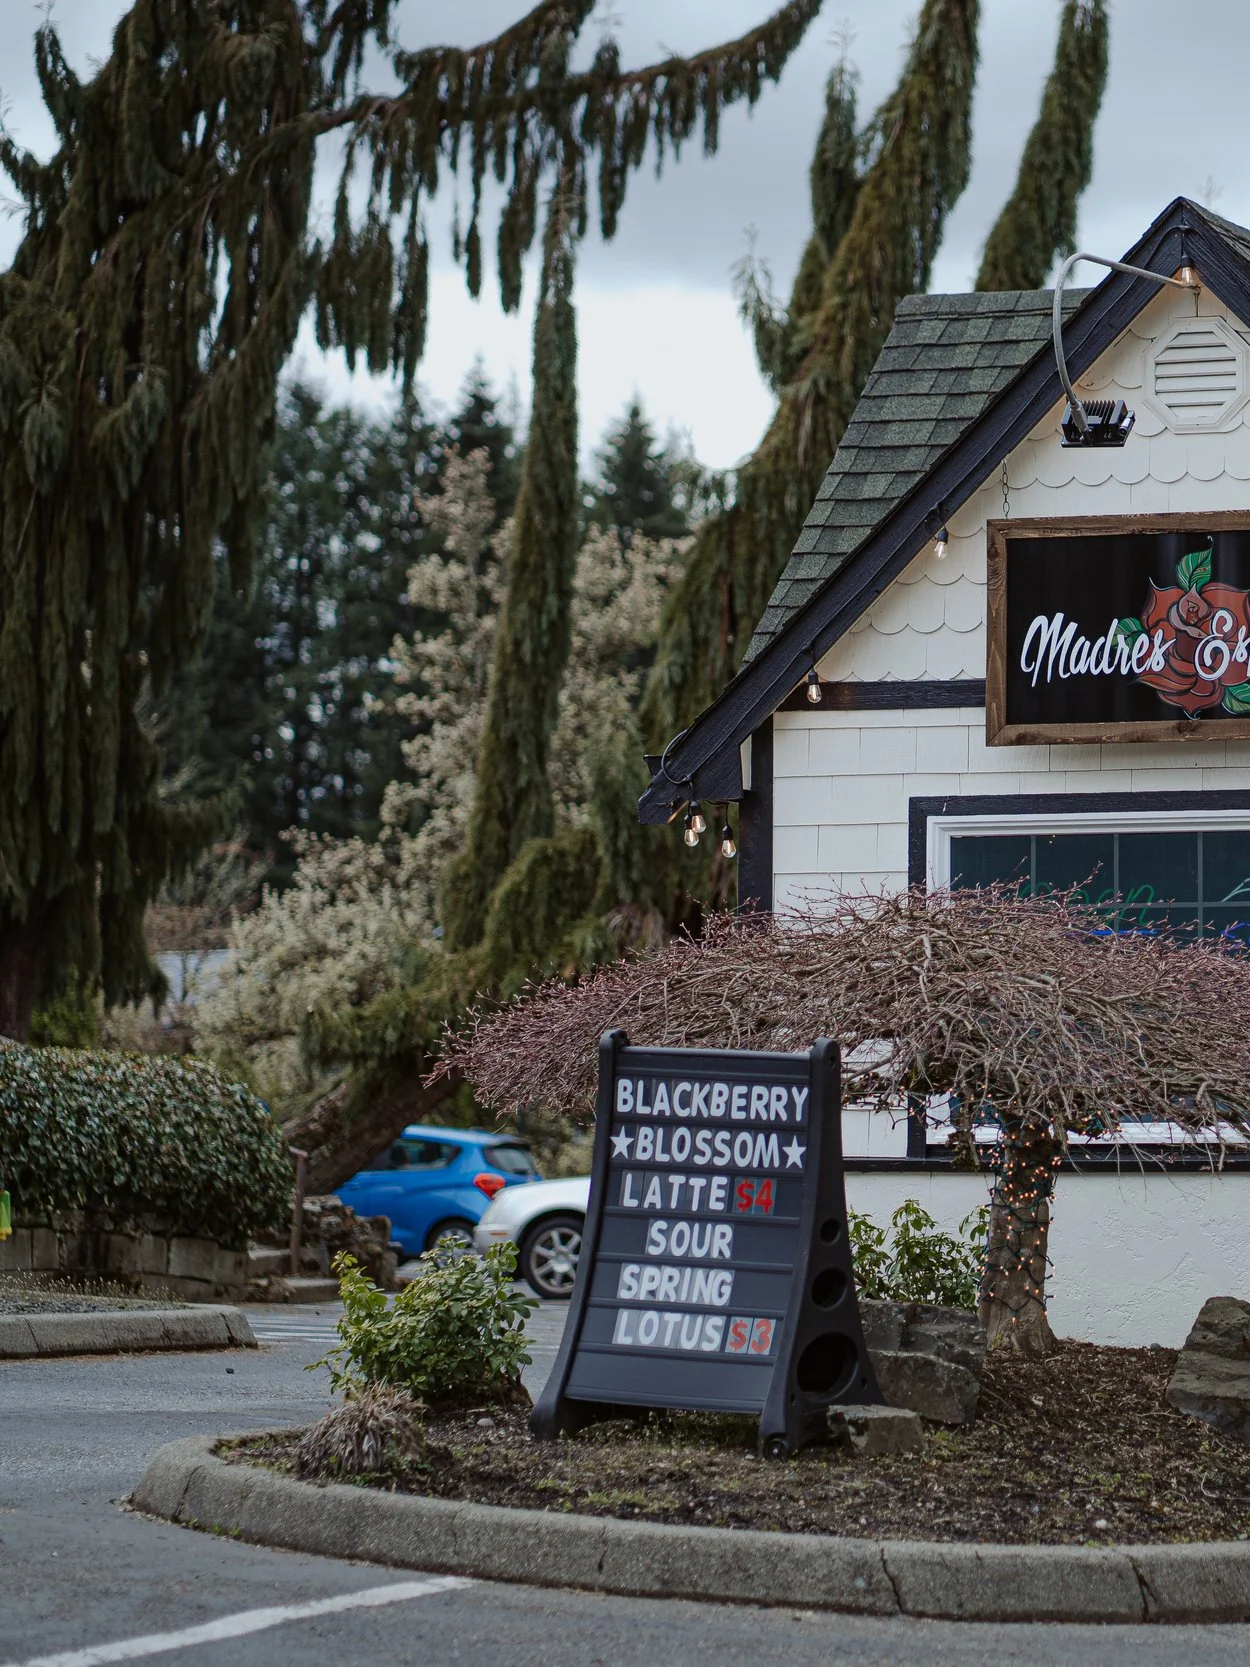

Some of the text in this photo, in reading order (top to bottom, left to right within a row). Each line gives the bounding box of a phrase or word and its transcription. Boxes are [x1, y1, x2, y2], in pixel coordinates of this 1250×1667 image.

[1021, 612, 1176, 688] Madres
[617, 1078, 809, 1122] BLACKBERRY
[636, 1126, 779, 1169] BLOSSOM
[622, 1173, 776, 1214] LATTE $4
[647, 1220, 733, 1260] SOUR
[620, 1264, 733, 1306] SPRING
[617, 1310, 773, 1355] LOTUS $3
